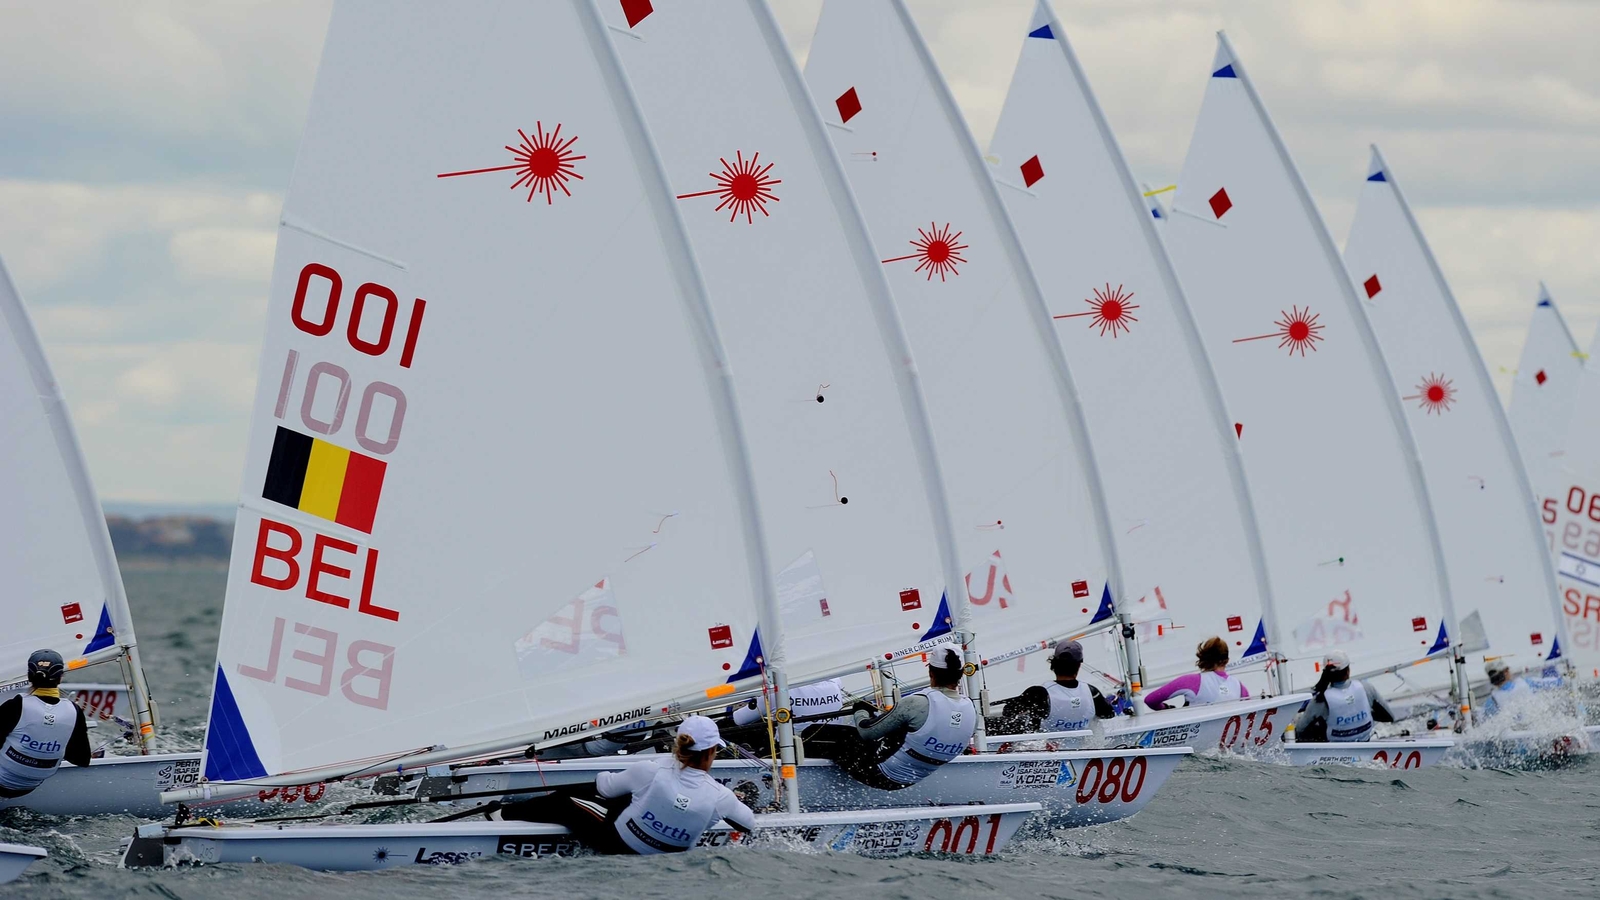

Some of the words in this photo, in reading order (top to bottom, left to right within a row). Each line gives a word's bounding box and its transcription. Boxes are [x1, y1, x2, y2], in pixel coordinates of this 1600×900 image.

[291, 263, 427, 369] 001
[251, 518, 400, 622] BEL
[893, 647, 914, 657] INNER
[913, 641, 937, 652] CIRCLE
[937, 635, 953, 645] RUM
[543, 720, 588, 741] MAGIC
[598, 706, 652, 727] MARINE
[1055, 718, 1089, 729] Perth
[1218, 707, 1278, 748] 015
[1336, 711, 1368, 725] Perth
[20, 734, 61, 752] Perth
[923, 736, 964, 754] Perth
[1154, 733, 1188, 744] WORLD
[8, 750, 38, 765] australia
[175, 760, 201, 768] PERTH
[1016, 774, 1057, 784] WORLD
[1075, 756, 1148, 804] 080
[628, 821, 661, 847] australia
[641, 811, 691, 842] Perth
[925, 814, 1002, 855] 001
